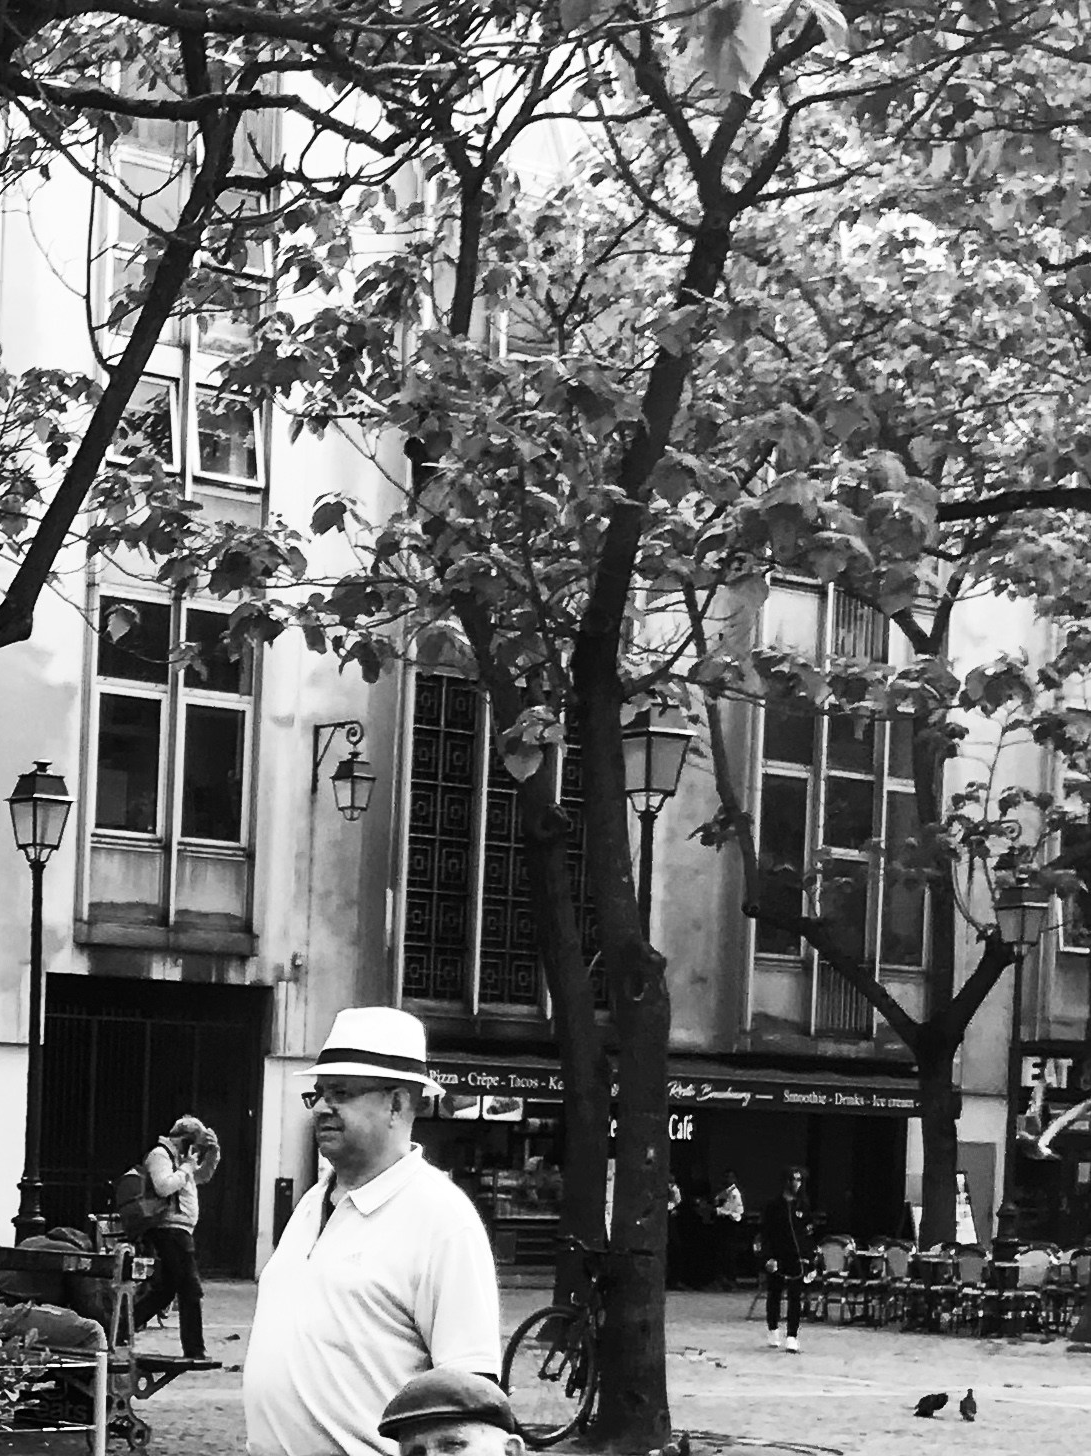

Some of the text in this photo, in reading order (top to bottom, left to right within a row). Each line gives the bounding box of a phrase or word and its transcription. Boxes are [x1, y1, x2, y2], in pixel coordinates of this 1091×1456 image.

[428, 1069, 459, 1085] Pizza
[508, 1074, 539, 1088] Tacos
[1020, 1056, 1074, 1089] EAT
[668, 1113, 694, 1140] Café
